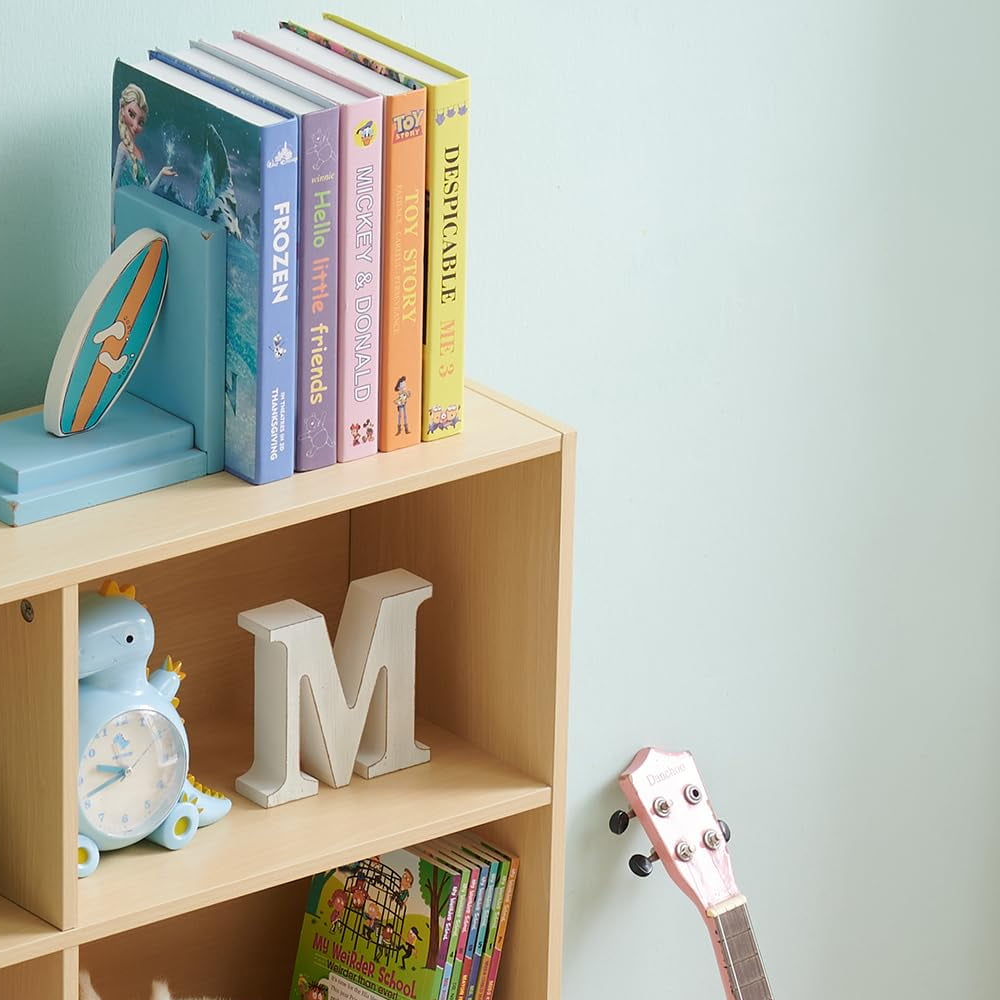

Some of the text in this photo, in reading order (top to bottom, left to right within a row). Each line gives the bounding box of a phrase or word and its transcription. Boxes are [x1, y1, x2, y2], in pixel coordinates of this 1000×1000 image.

[393, 110, 425, 134] TOY
[272, 201, 290, 304] FROZEN
[310, 190, 331, 405] Hello little friends
[354, 164, 373, 402] MICKEY & DONALD
[402, 189, 419, 322] TOY STORY
[439, 146, 460, 380] DESPICABLE ME 3
[270, 387, 279, 461] THANKSGIVING
[328, 960, 356, 983] Weirder
